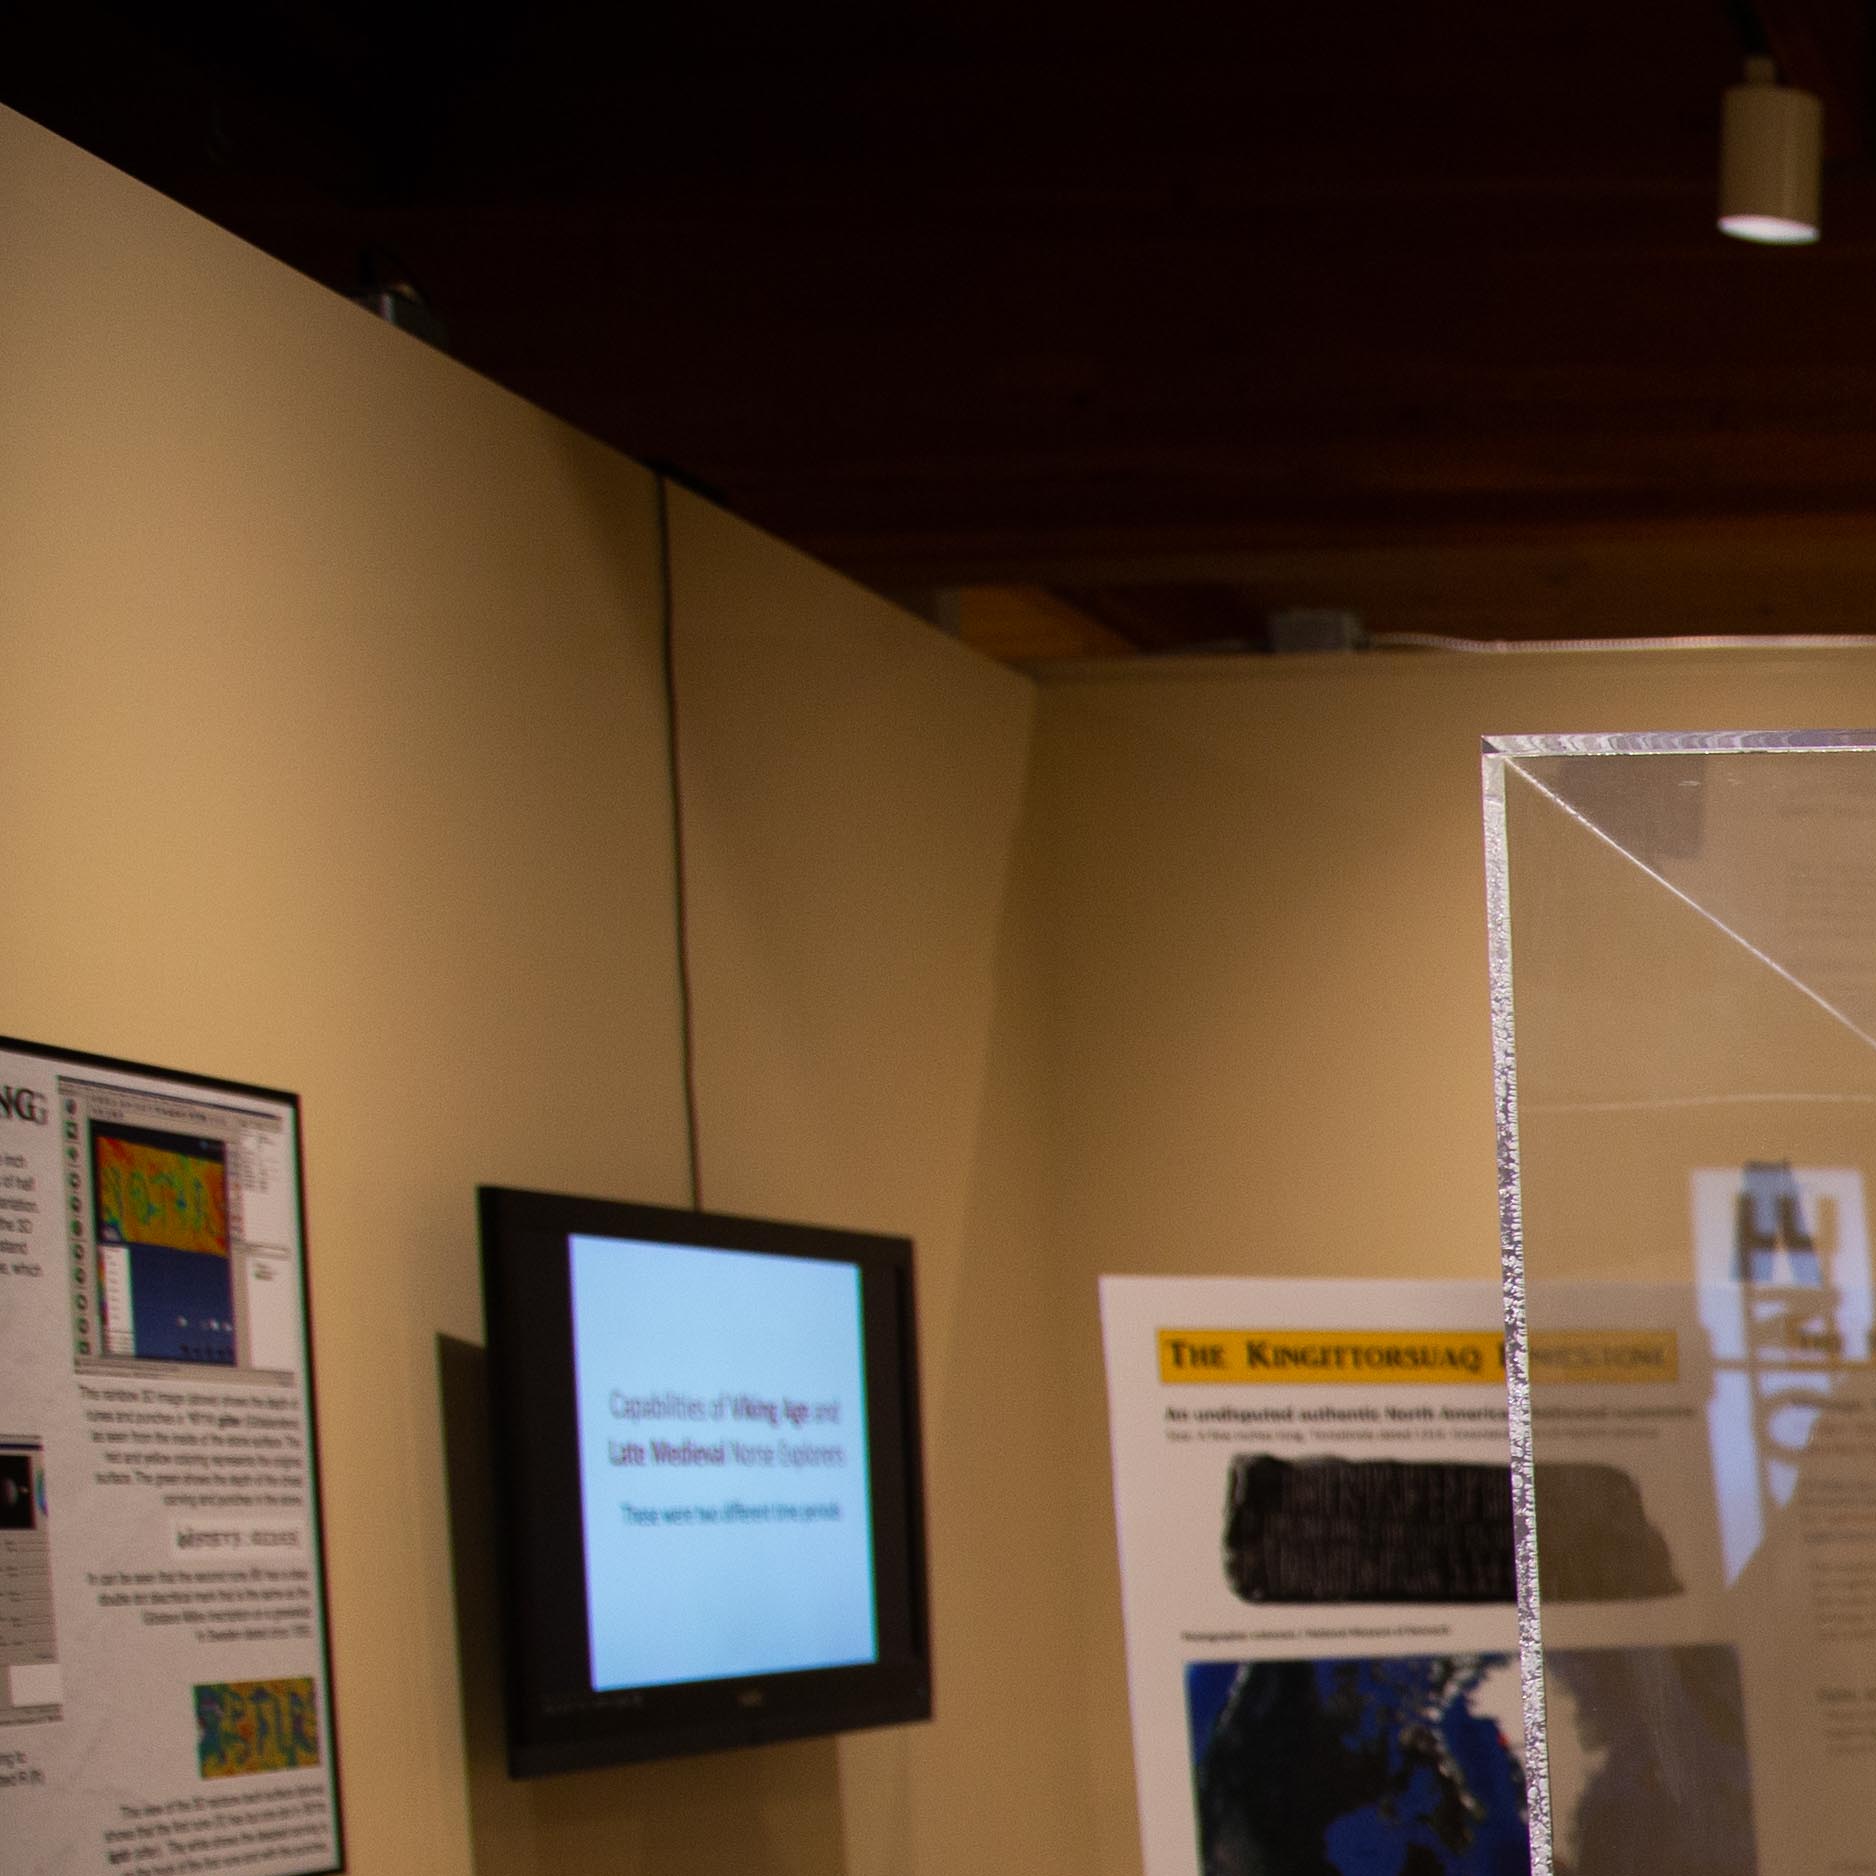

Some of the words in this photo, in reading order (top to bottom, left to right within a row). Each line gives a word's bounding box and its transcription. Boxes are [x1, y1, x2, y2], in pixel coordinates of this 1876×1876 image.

[609, 1389, 706, 1424] Capabilities
[732, 1391, 777, 1427] Viking
[783, 1395, 809, 1427] Age
[608, 1440, 645, 1467] Late
[651, 1438, 725, 1467] Medieval
